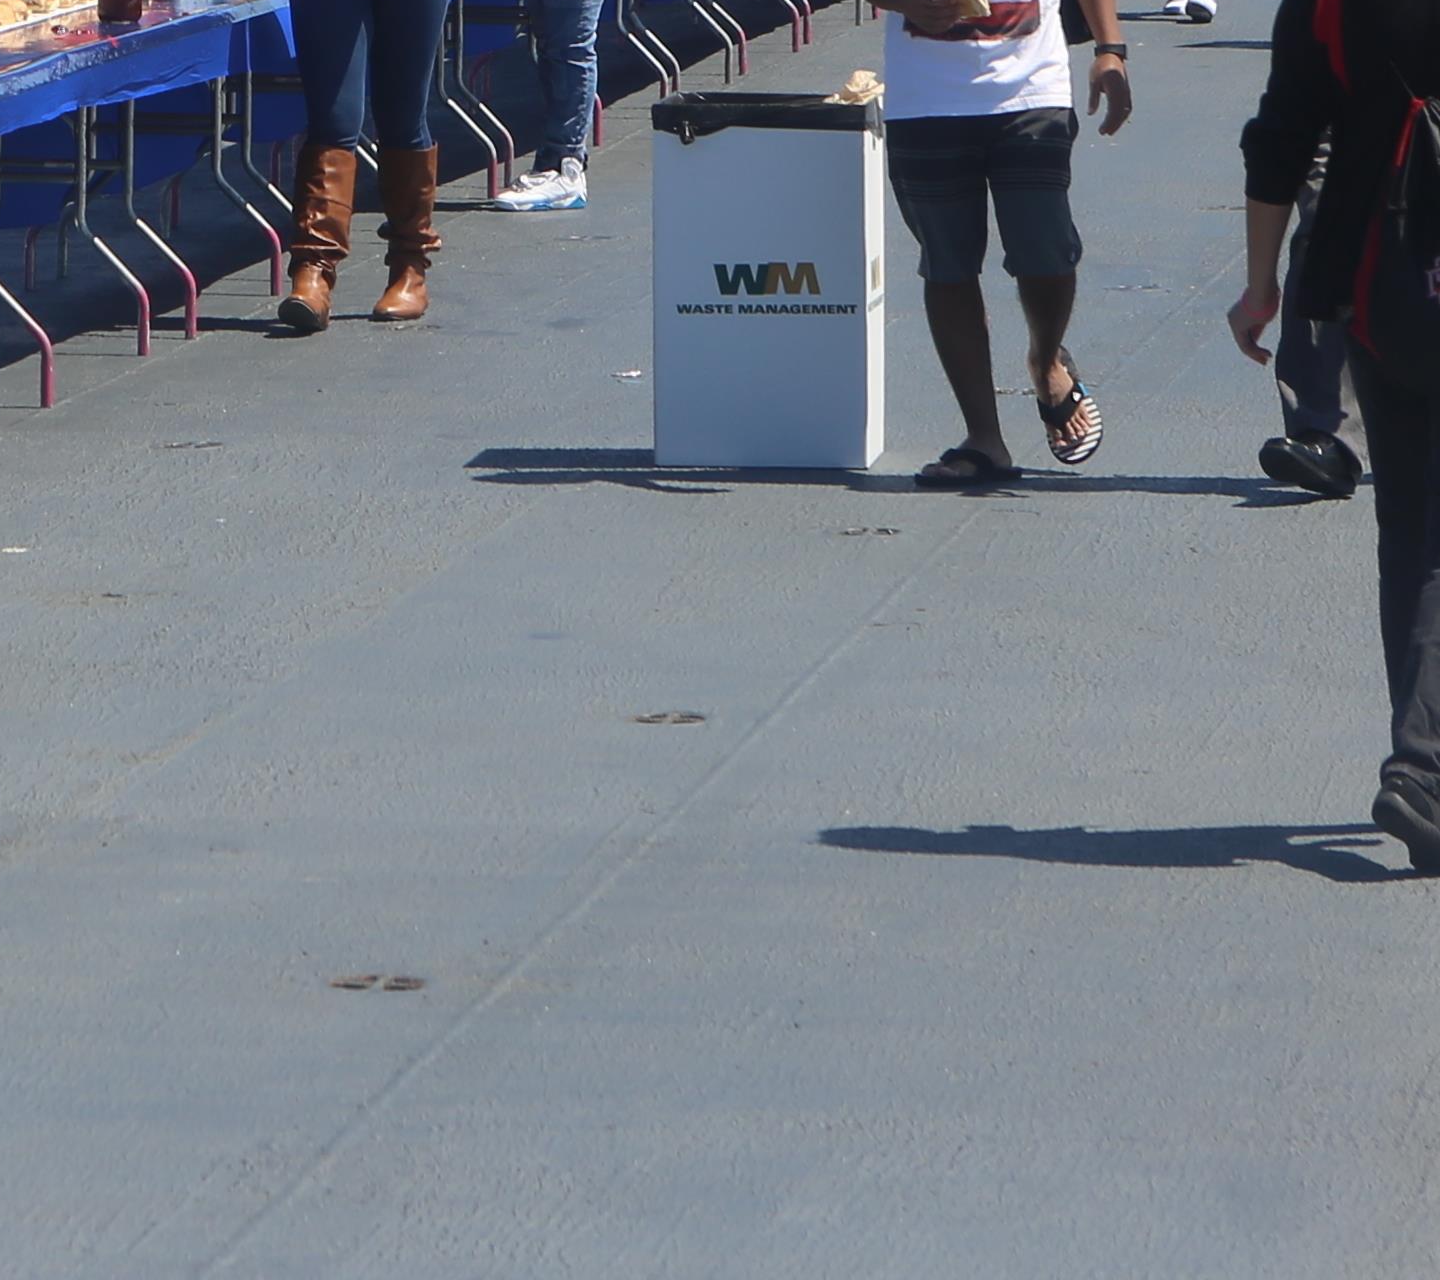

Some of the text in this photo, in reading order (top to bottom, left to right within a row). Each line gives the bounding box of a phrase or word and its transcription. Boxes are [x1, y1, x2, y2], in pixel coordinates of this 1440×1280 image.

[713, 261, 822, 296] WM
[676, 303, 734, 315] WASTE
[737, 303, 858, 315] MANAGEMENT
